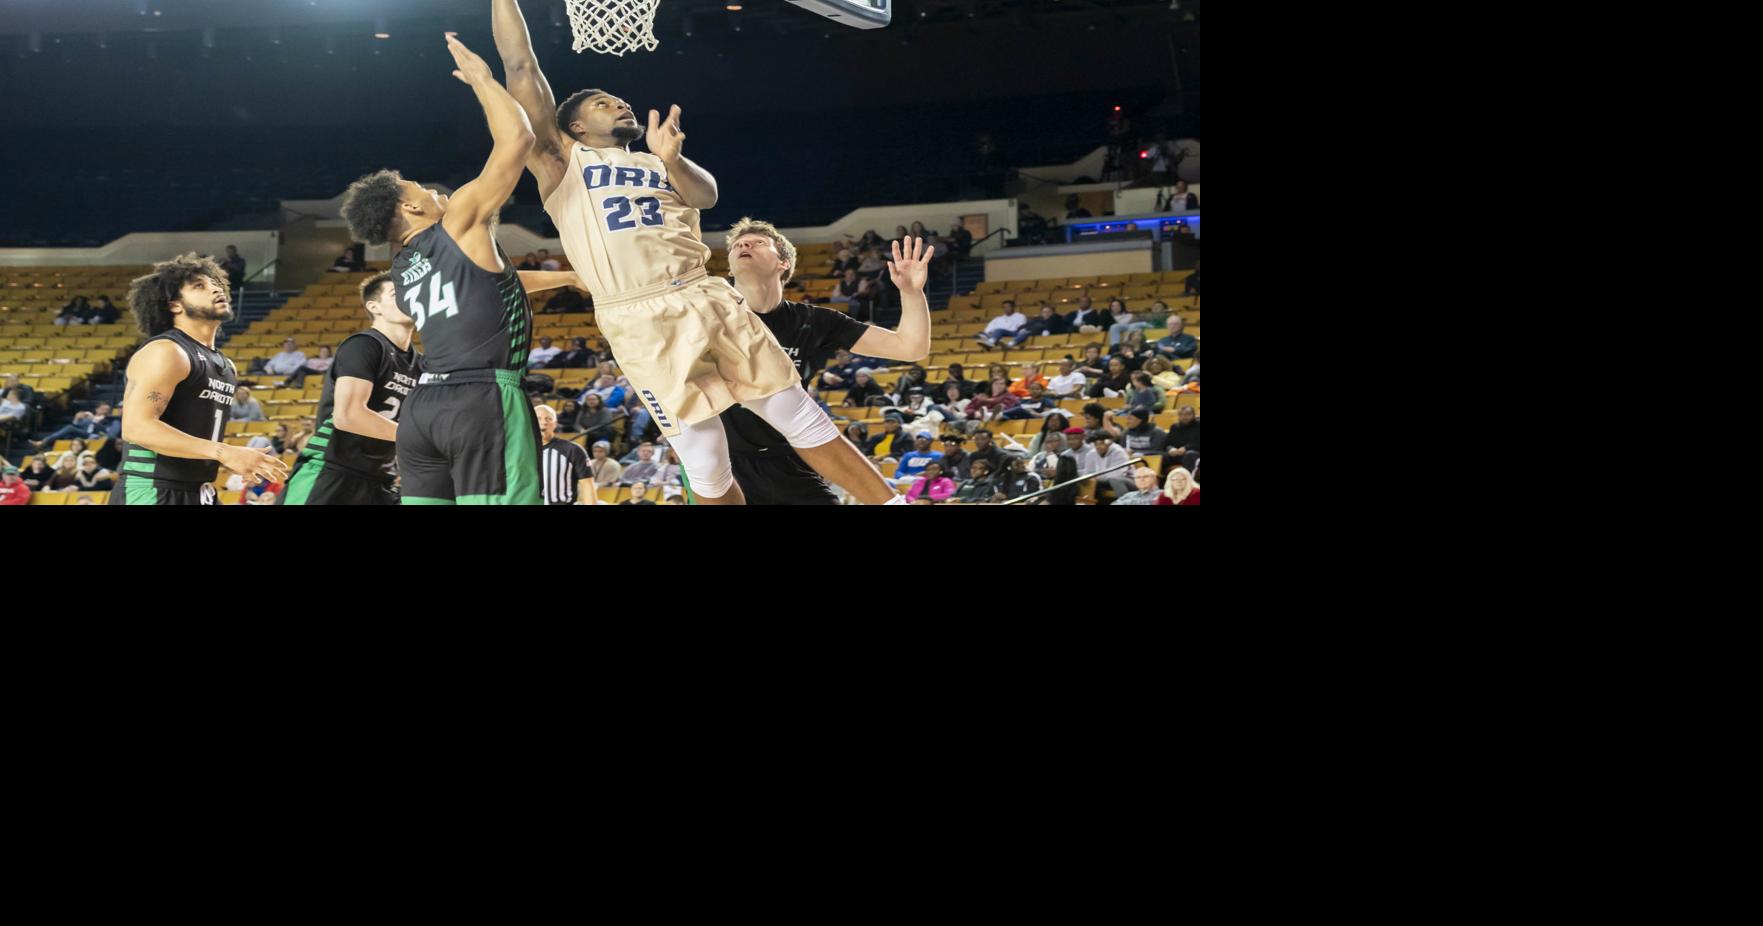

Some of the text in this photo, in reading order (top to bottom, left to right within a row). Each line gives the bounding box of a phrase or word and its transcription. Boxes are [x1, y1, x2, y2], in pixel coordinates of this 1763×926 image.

[602, 195, 665, 233] 23
[403, 270, 460, 332] 34
[198, 389, 234, 406] DAKOT
[208, 377, 236, 394] NORTH
[211, 408, 224, 442] 1
